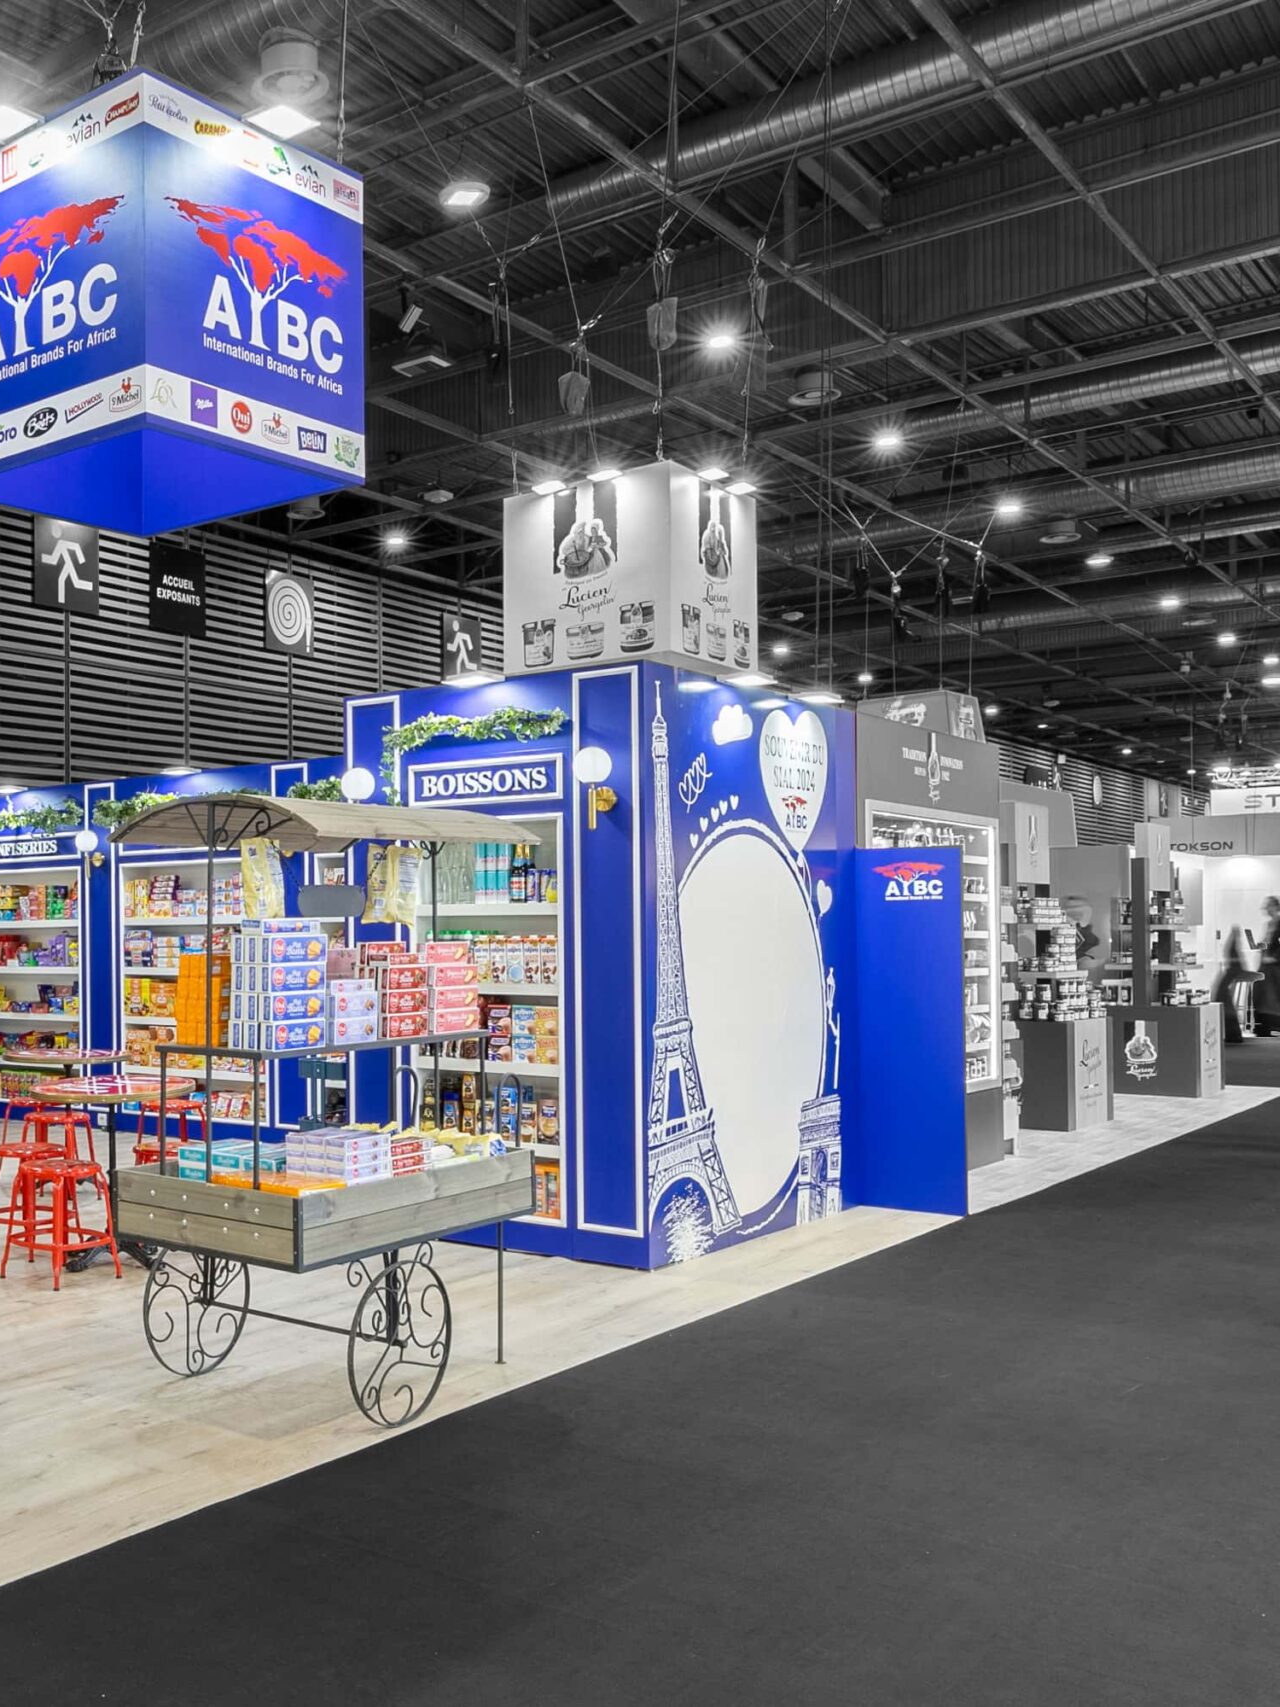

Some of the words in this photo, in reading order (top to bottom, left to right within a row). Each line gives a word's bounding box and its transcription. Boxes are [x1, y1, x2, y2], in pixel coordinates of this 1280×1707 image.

[66, 120, 101, 148] evian
[194, 119, 231, 136] CARAMB
[295, 173, 326, 198] evian
[31, 345, 64, 369] Brands
[67, 339, 84, 355] For
[86, 327, 117, 348] Africa
[203, 333, 264, 367] International
[267, 355, 298, 379] Brands
[301, 368, 315, 385] For
[317, 375, 343, 395] Africa
[68, 393, 103, 416] HOLLYWOOD
[163, 574, 195, 591] ACCUEIL
[157, 587, 200, 606] EXPOSANTS
[559, 584, 611, 609] Lucien
[813, 744, 824, 765] DU
[422, 767, 547, 797] BOISSONS
[774, 766, 794, 789] SIAL
[797, 769, 815, 792] 2024
[1170, 841, 1233, 852] TOKSON
